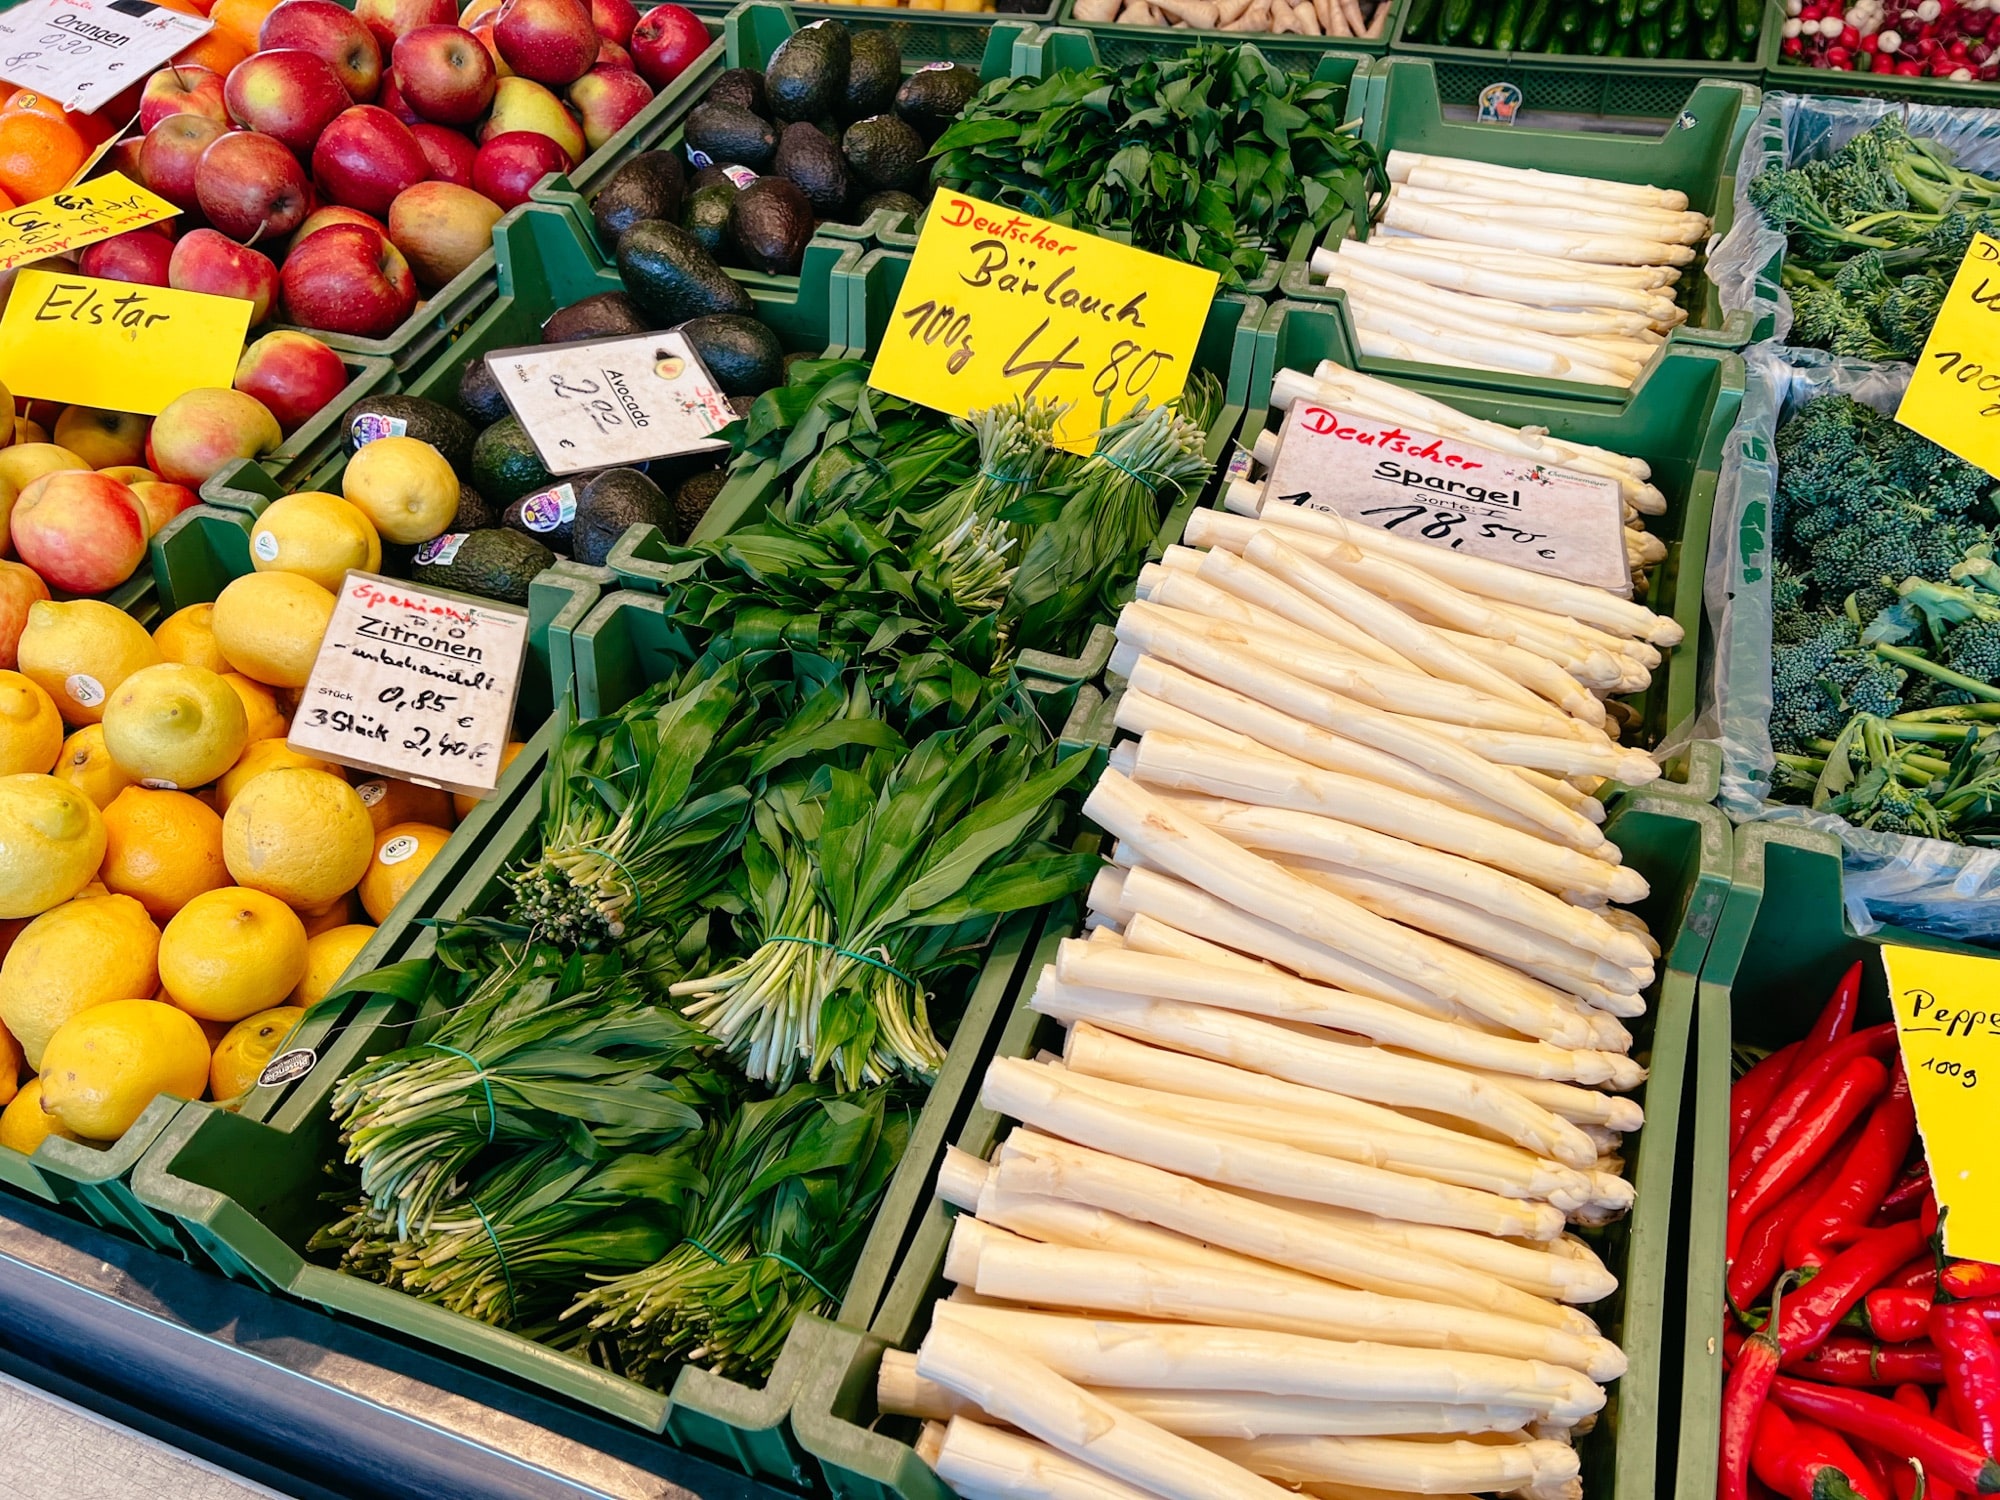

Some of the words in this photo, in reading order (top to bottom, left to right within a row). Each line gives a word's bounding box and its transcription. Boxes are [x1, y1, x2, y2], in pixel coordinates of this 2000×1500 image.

[39, 33, 93, 55] 0,90
[53, 13, 131, 47] Orangen
[941, 199, 1077, 256] Deutscher
[959, 239, 1147, 328] Bärlauch
[35, 284, 170, 328] Elstar
[903, 300, 975, 375] 100g
[514, 364, 531, 384] Stück
[606, 369, 650, 428] Avocado
[559, 438, 576, 448] €
[1300, 407, 1483, 471] Deutscher
[1374, 460, 1521, 508] Spargel
[1413, 493, 1476, 513] Sorte:
[1537, 548, 1557, 560] €
[357, 616, 483, 660] Zitronen
[318, 687, 353, 702] Stück
[378, 686, 458, 713] 0,85
[456, 716, 475, 729] €
[1903, 988, 2000, 1036] Peppe
[1921, 1058, 1977, 1088] 100g
